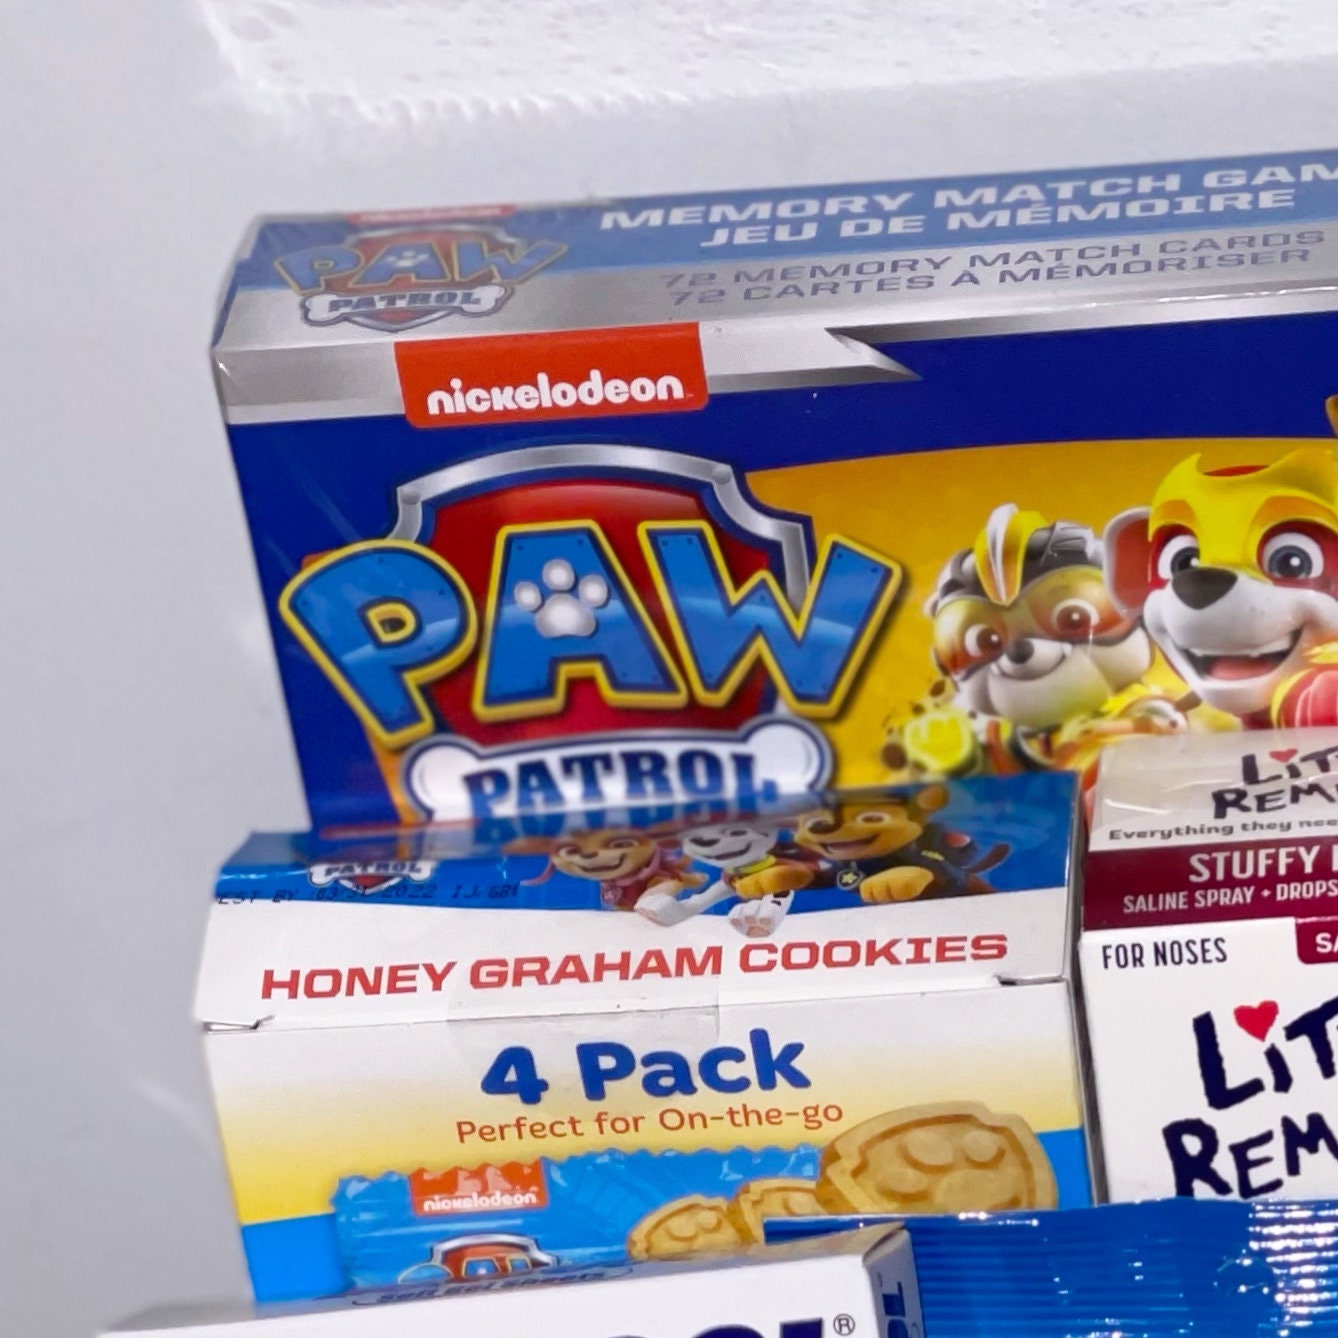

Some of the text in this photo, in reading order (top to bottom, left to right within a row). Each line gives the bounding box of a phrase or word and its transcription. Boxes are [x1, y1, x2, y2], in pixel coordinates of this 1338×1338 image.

[601, 192, 915, 230] MEMORY
[934, 174, 1181, 208] MATCH
[700, 188, 1296, 248] JEU DE MÉMOIRE
[274, 238, 568, 291] PAW
[734, 255, 953, 284] MEMORY
[968, 244, 1141, 269] MATCH
[1159, 230, 1326, 255] CARDS
[744, 275, 935, 302] CARTES
[999, 248, 1310, 284] MÉMORISER
[328, 291, 482, 313] PATROL
[426, 369, 685, 416] nickelodeon
[279, 519, 902, 748] PAW
[461, 750, 778, 812] PATROL
[1108, 822, 1234, 841] Everything
[1241, 819, 1292, 834] they
[1188, 845, 1322, 884] STUFFY
[1123, 890, 1189, 914] SALINE
[1194, 885, 1256, 908] SPRAY
[1276, 879, 1338, 902] DROPS
[261, 933, 1009, 1000] HONEY GRAHAM COOKIES
[1101, 937, 1229, 970] FOR NOSES
[480, 1027, 812, 1106] 4 Pack
[456, 1102, 844, 1144] Perfect for On-the-go
[423, 1191, 538, 1212] nickelodeon
